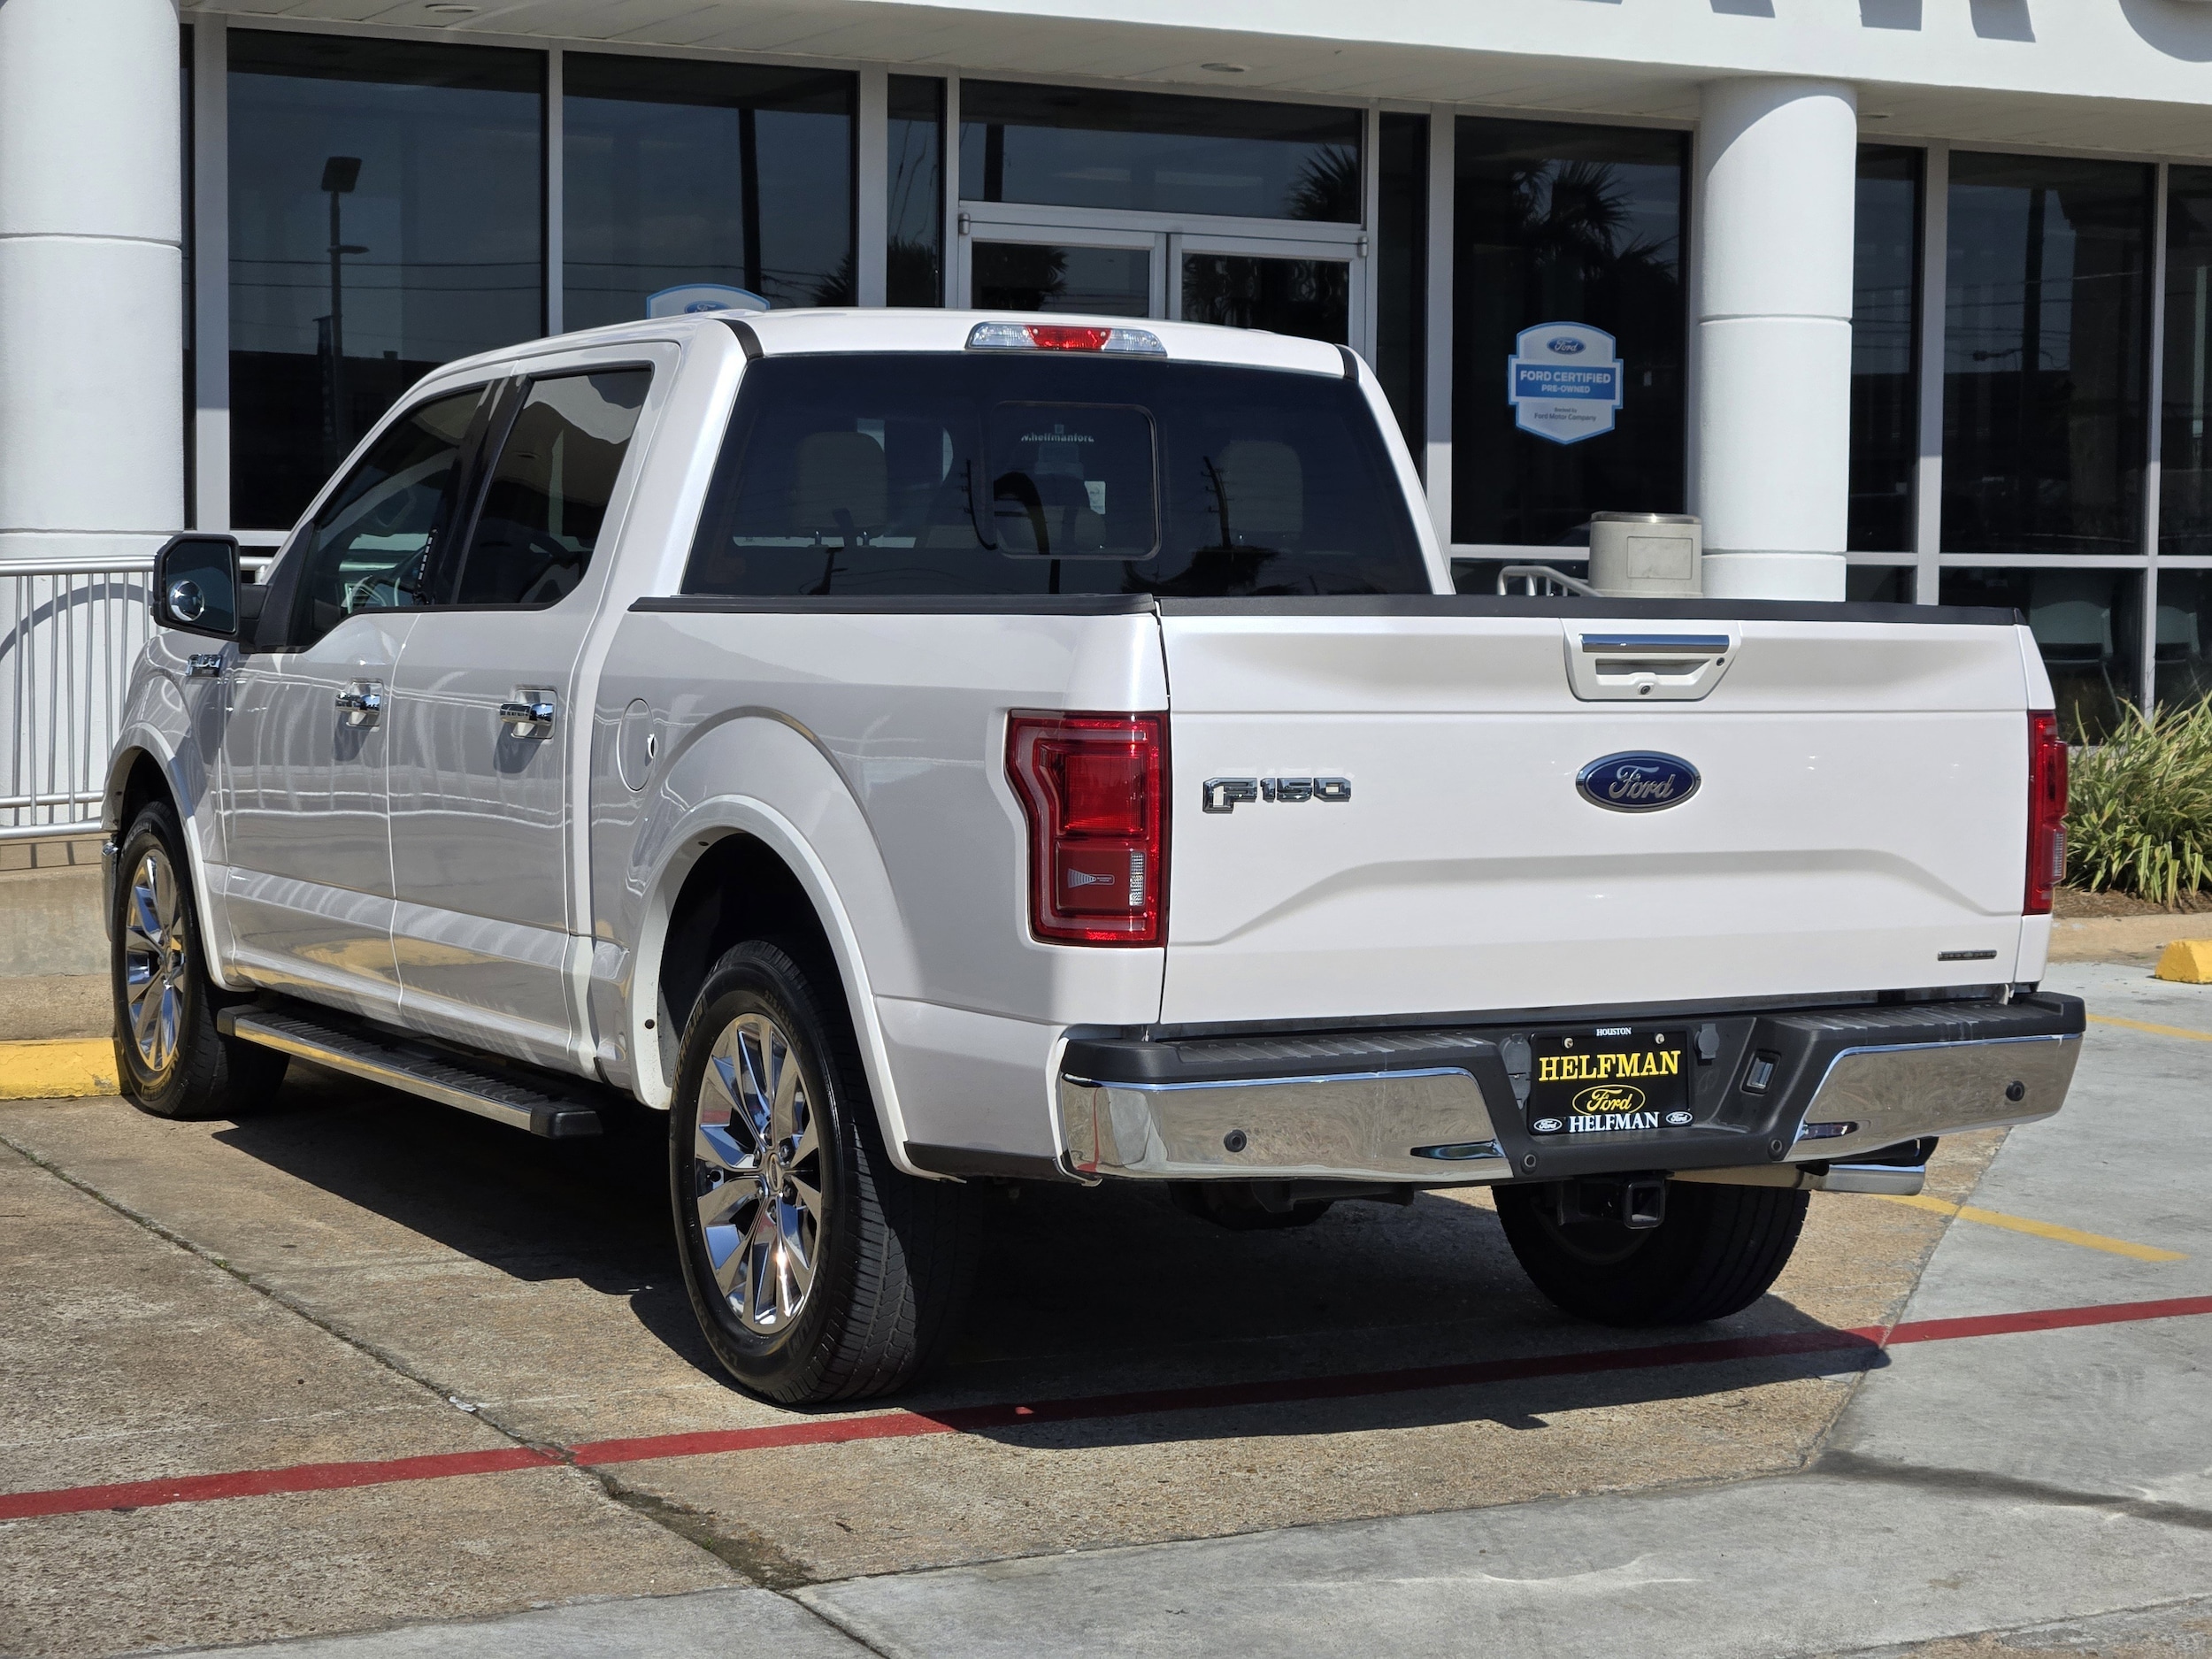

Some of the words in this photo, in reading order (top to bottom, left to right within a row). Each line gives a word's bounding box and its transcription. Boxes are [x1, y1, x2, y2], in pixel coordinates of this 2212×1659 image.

[1554, 339, 1579, 352] Ford
[1520, 370, 1552, 381] FORD
[1553, 372, 1611, 384] CERTIFIED
[1541, 384, 1591, 394] PRE-OWNED
[1609, 764, 1676, 799] Ford
[1596, 1027, 1632, 1036] HOUSTON
[1538, 1050, 1681, 1081] HELFMAN
[1586, 1088, 1633, 1111] Ford
[1569, 1111, 1660, 1133] HELFMAN
[1671, 1112, 1689, 1124] Ford
[1539, 1119, 1557, 1131] Ford
